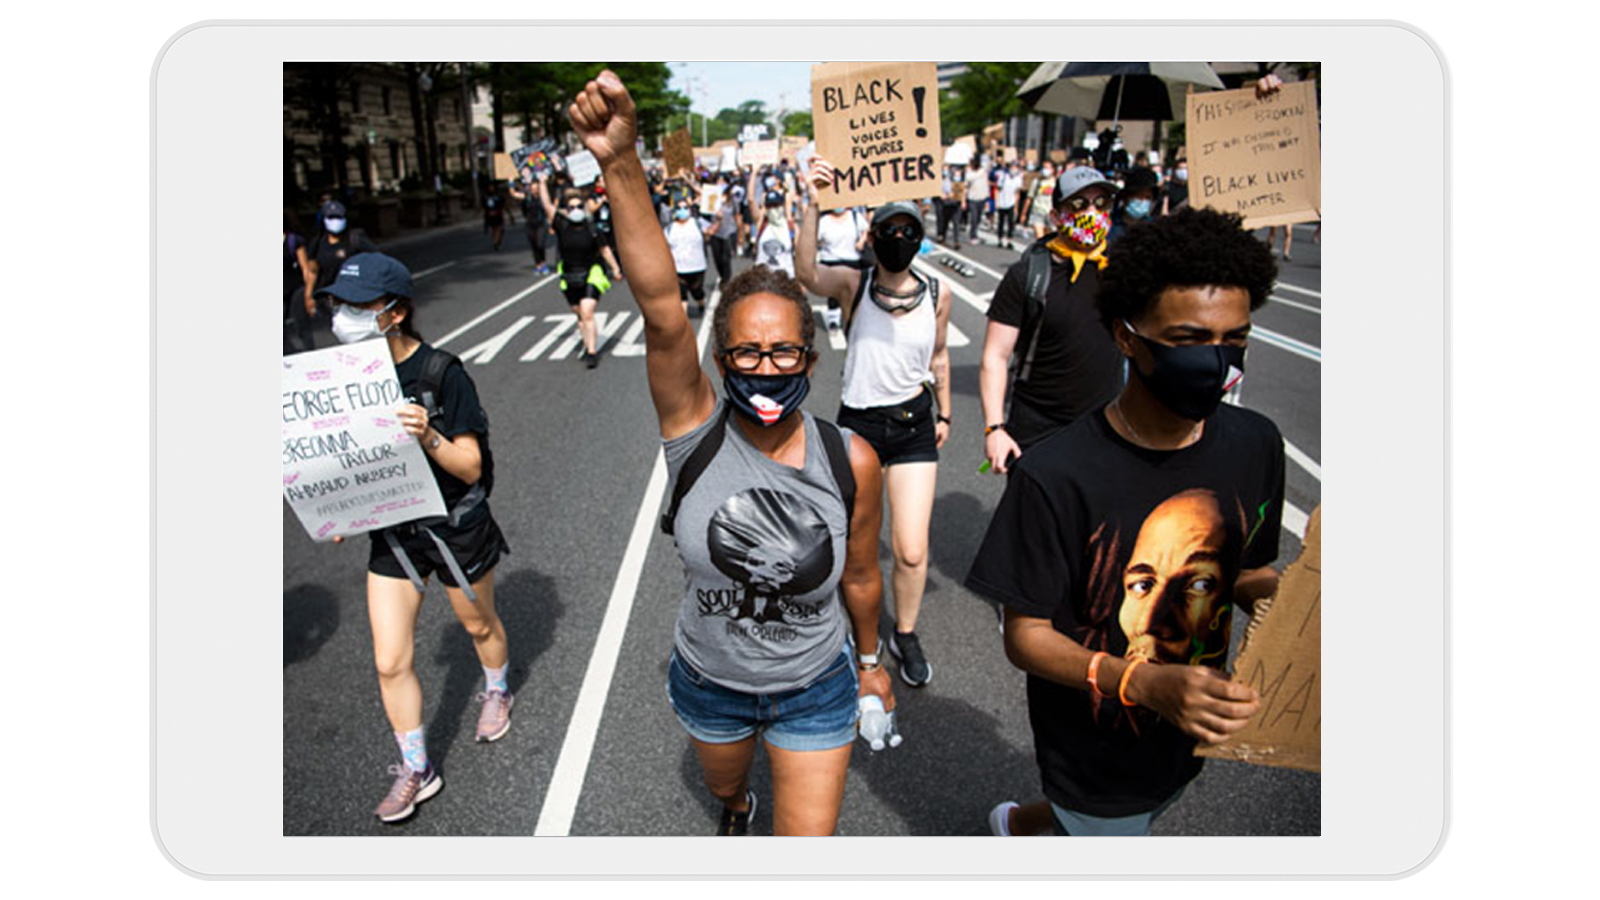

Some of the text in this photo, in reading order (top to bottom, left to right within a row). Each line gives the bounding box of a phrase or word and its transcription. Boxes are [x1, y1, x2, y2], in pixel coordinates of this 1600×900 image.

[823, 78, 904, 113] BLACK
[849, 110, 896, 130] LIVES
[851, 126, 898, 144] VOICES
[852, 140, 904, 160] FUTURES
[833, 154, 936, 195] MATTER
[1203, 168, 1306, 198] BLACK LIVES
[1237, 192, 1286, 211] MATTER
[345, 379, 400, 410] FLOYD
[333, 443, 398, 470] TAYLOR
[286, 476, 350, 502] AHMAUD
[354, 462, 408, 486] ARBERY
[1247, 659, 1321, 732] MA
